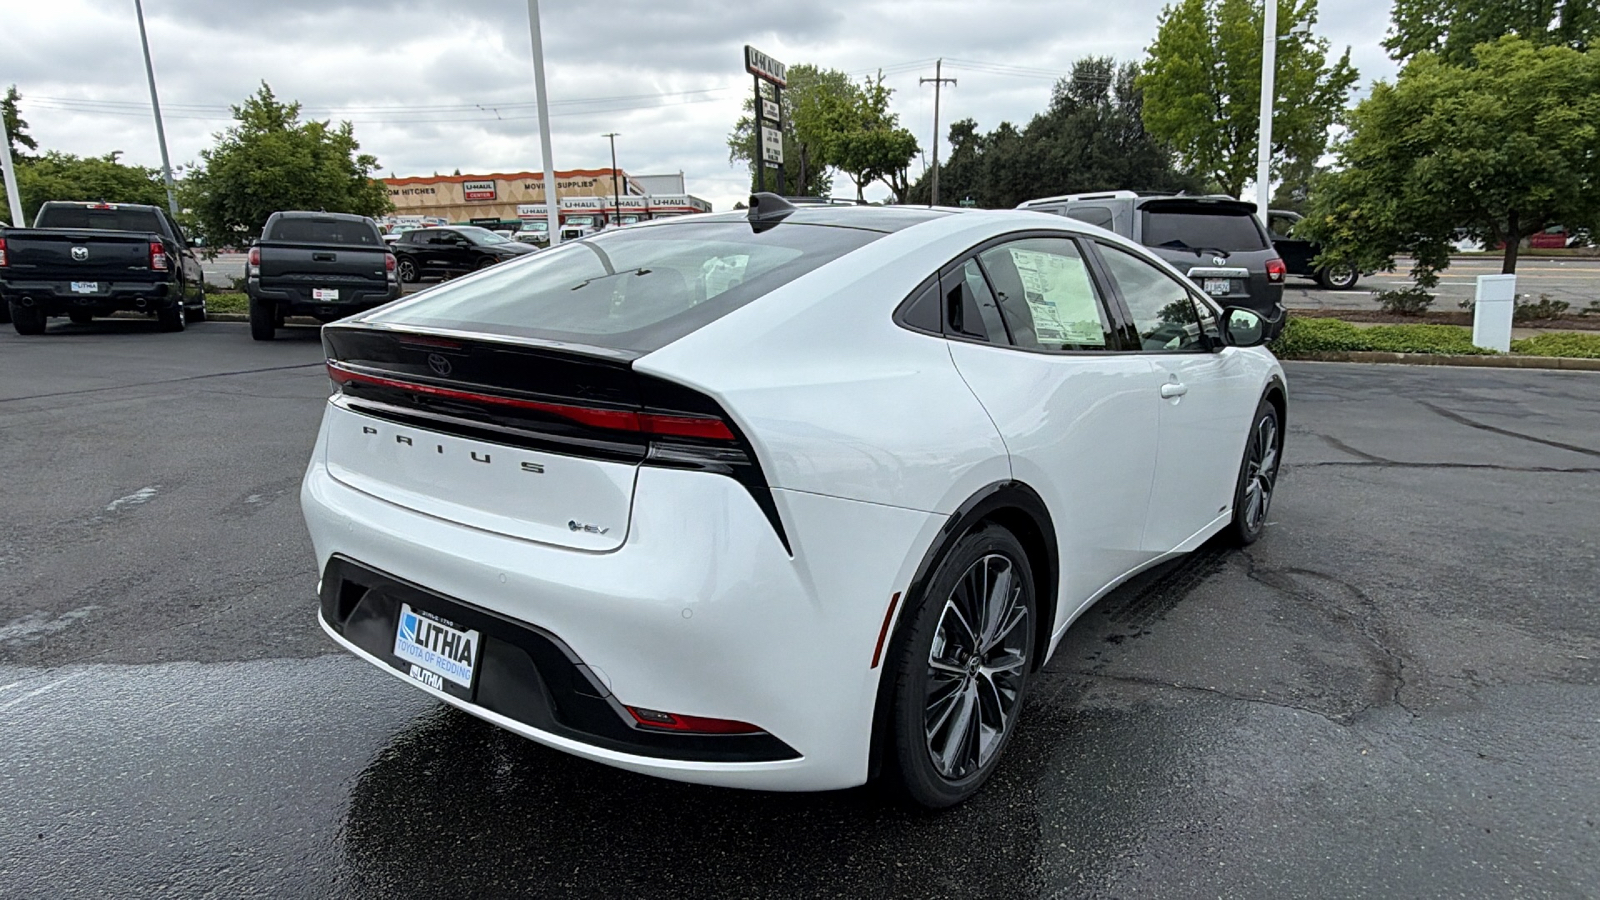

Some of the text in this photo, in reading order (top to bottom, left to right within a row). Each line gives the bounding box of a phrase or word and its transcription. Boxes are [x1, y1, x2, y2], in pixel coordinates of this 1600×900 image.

[402, 188, 436, 196] HITCHES
[557, 181, 594, 189] SUPPLIES
[362, 425, 545, 474] PRIUS
[415, 618, 473, 668] LITHIA
[397, 639, 471, 681] TOYOTA OF REDDING
[417, 667, 443, 691] LITHIA
